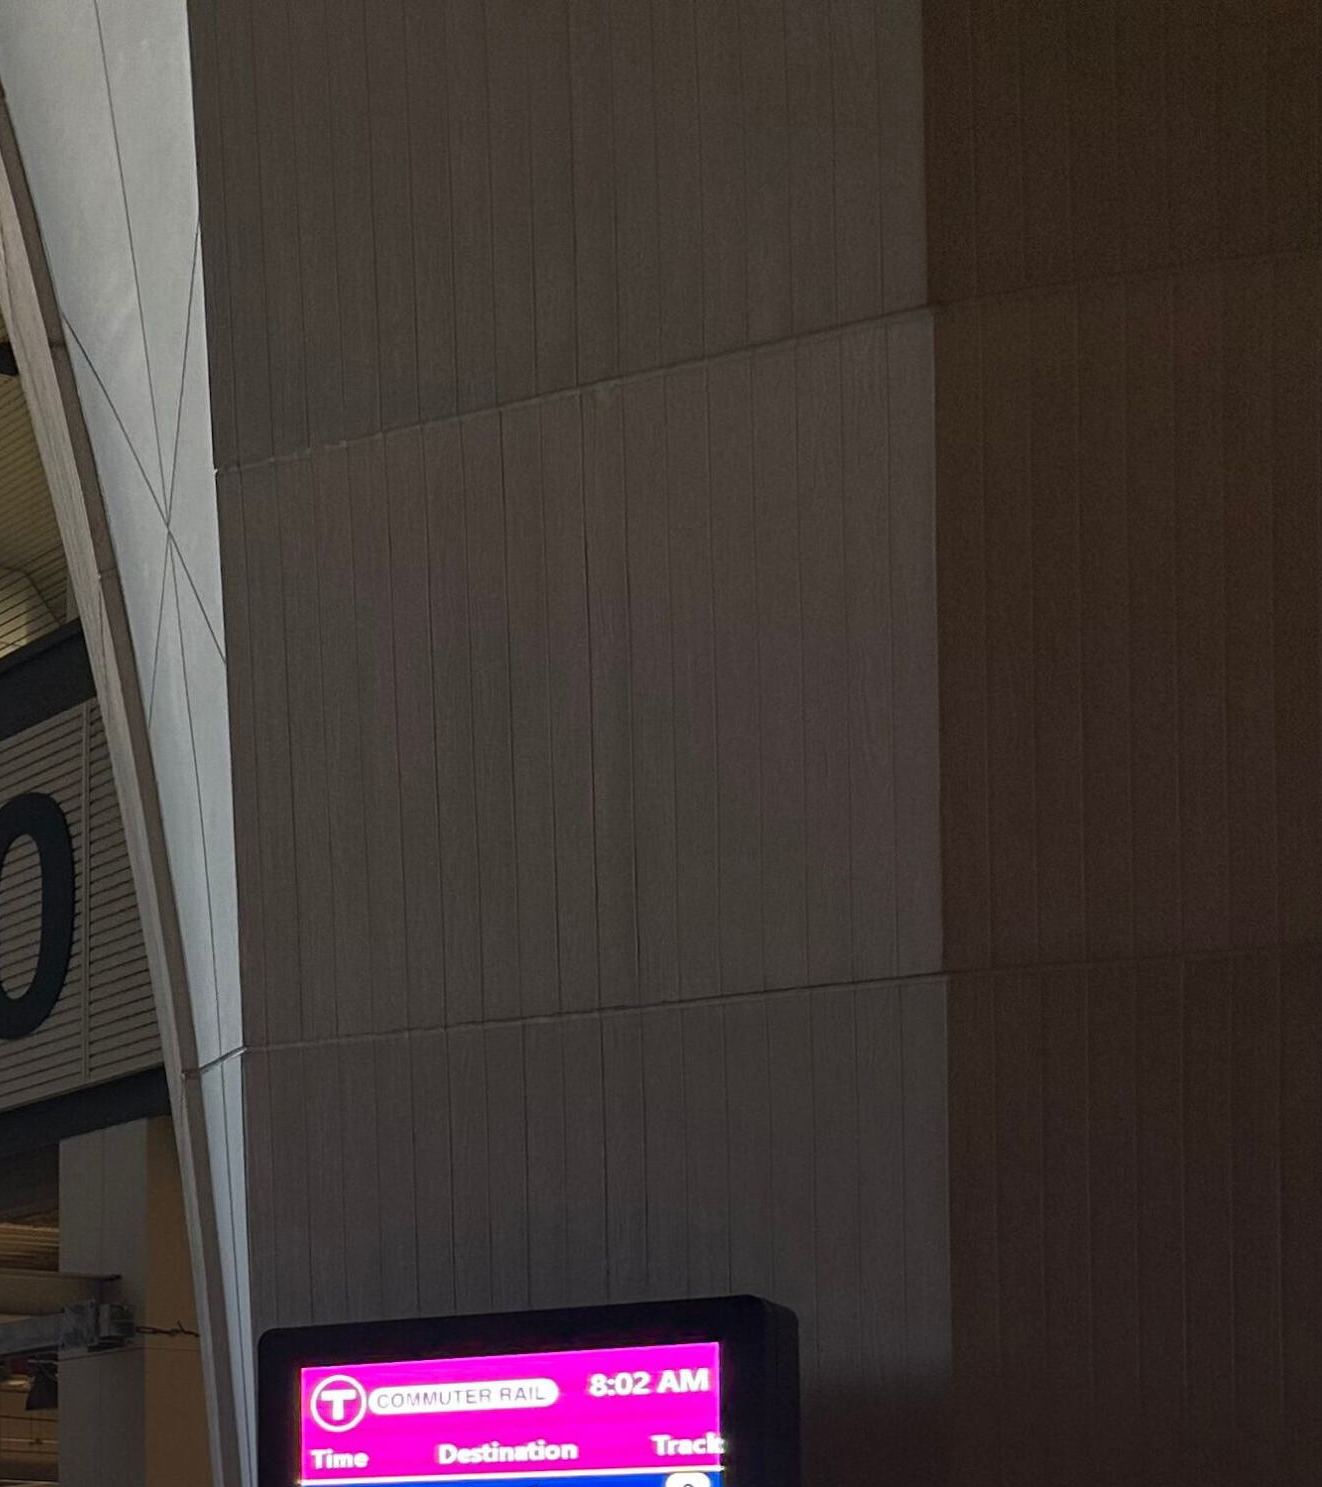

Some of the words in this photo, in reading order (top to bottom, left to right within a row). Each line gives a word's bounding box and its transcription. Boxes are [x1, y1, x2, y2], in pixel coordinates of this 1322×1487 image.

[589, 1373, 650, 1397] 8:02
[657, 1367, 709, 1393] AM
[377, 1390, 490, 1409] COMMUTER
[499, 1386, 545, 1403] RAIL
[311, 1449, 368, 1468] Time
[439, 1440, 577, 1464] Destination
[651, 1432, 725, 1455] Track
